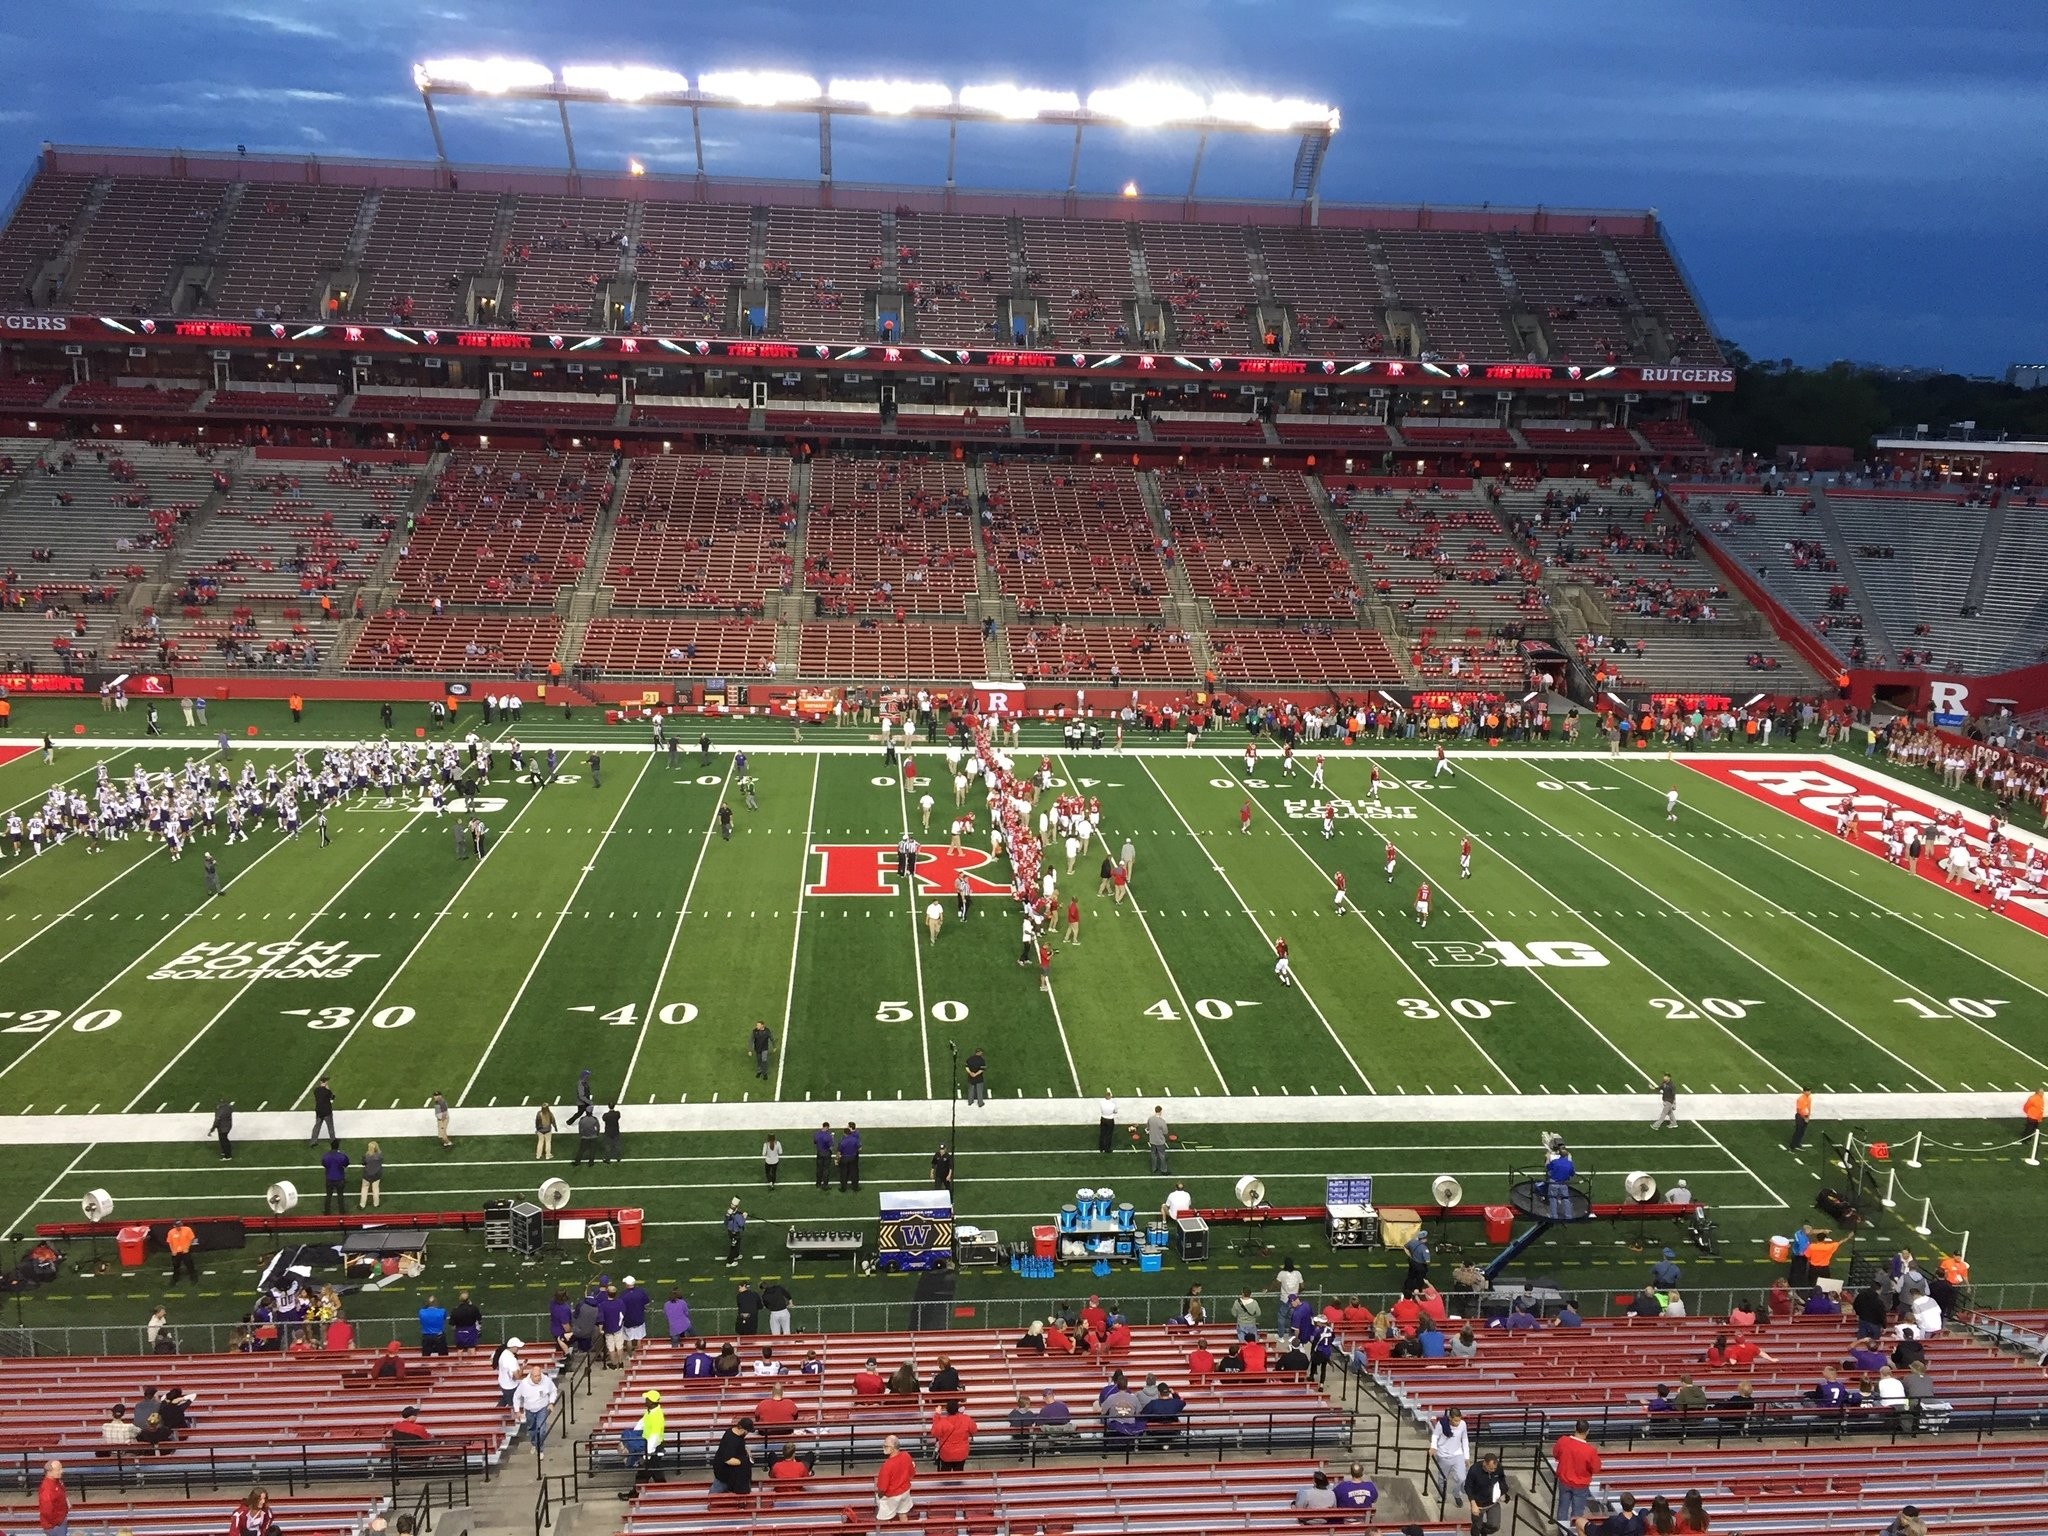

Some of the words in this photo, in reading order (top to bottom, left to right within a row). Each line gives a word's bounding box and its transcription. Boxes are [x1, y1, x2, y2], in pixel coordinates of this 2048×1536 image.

[0, 316, 67, 331] GERS
[1641, 368, 1733, 383] RUTGERS
[988, 693, 1008, 711] R
[1931, 681, 1968, 716] R
[1286, 806, 1417, 814] POINT
[805, 844, 1018, 896] R
[181, 941, 349, 956] HIGH
[159, 954, 381, 970] POINT
[147, 968, 353, 980] SOLUTIONS
[306, 1006, 416, 1029] 30
[600, 1002, 698, 1026] 40
[875, 1000, 969, 1023] 50
[1143, 997, 1233, 1020] 40
[1396, 997, 1492, 1020] 30
[1648, 997, 1747, 1019] 20
[1893, 997, 1997, 1018] 10
[1, 1008, 123, 1033] 20
[901, 1225, 931, 1246] W
[694, 1358, 701, 1375] 1
